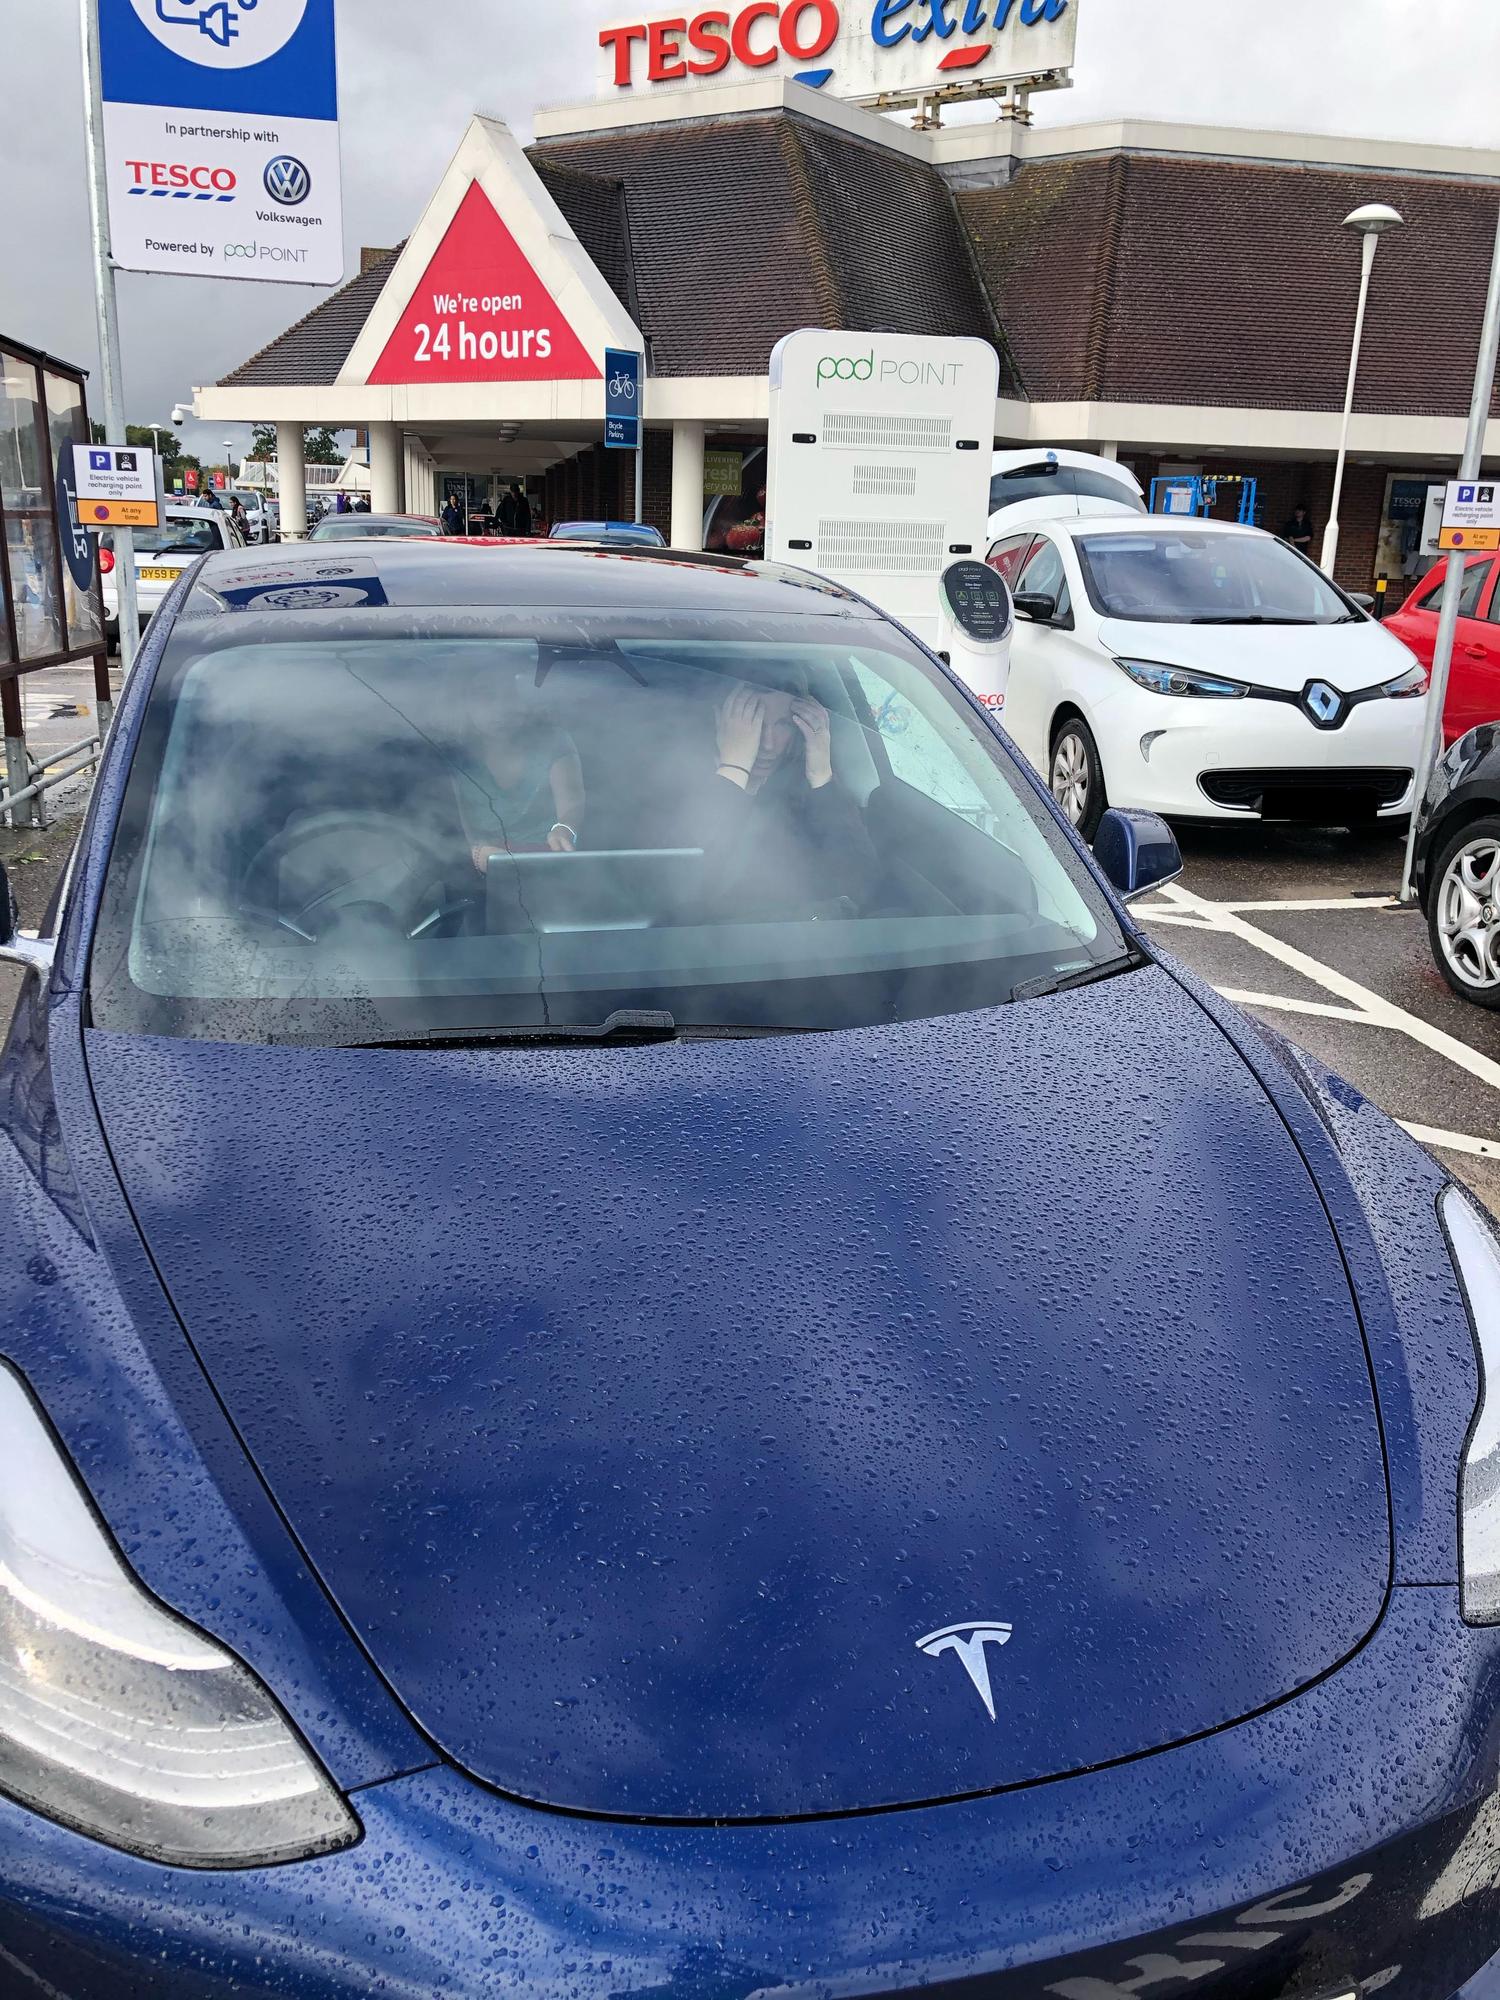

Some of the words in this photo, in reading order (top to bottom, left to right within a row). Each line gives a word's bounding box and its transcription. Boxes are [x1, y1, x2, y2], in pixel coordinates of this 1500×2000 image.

[599, 0, 839, 86] TESCO
[165, 122, 177, 134] In
[180, 125, 251, 143] partnership
[253, 130, 279, 143] with
[125, 160, 237, 191] TESCO
[256, 210, 323, 227] Volkswagen
[145, 238, 197, 253] Powered
[200, 243, 215, 257] by
[224, 240, 257, 262] pod
[260, 246, 309, 263] POINT
[433, 292, 478, 315] We're
[481, 294, 523, 316] open
[413, 322, 451, 362] 24
[458, 321, 553, 361] hours
[816, 347, 874, 389] pod
[880, 359, 964, 386] POINT
[608, 421, 623, 430] Bicycle
[608, 430, 624, 440] Parking
[704, 456, 739, 464] LIVERING
[704, 464, 739, 481] resh
[88, 482, 124, 490] recharging
[125, 483, 143, 491] point
[721, 483, 738, 491] DAY
[1392, 496, 1422, 505] TESCO
[141, 569, 167, 579] DY59
[977, 693, 1005, 706] SCO
